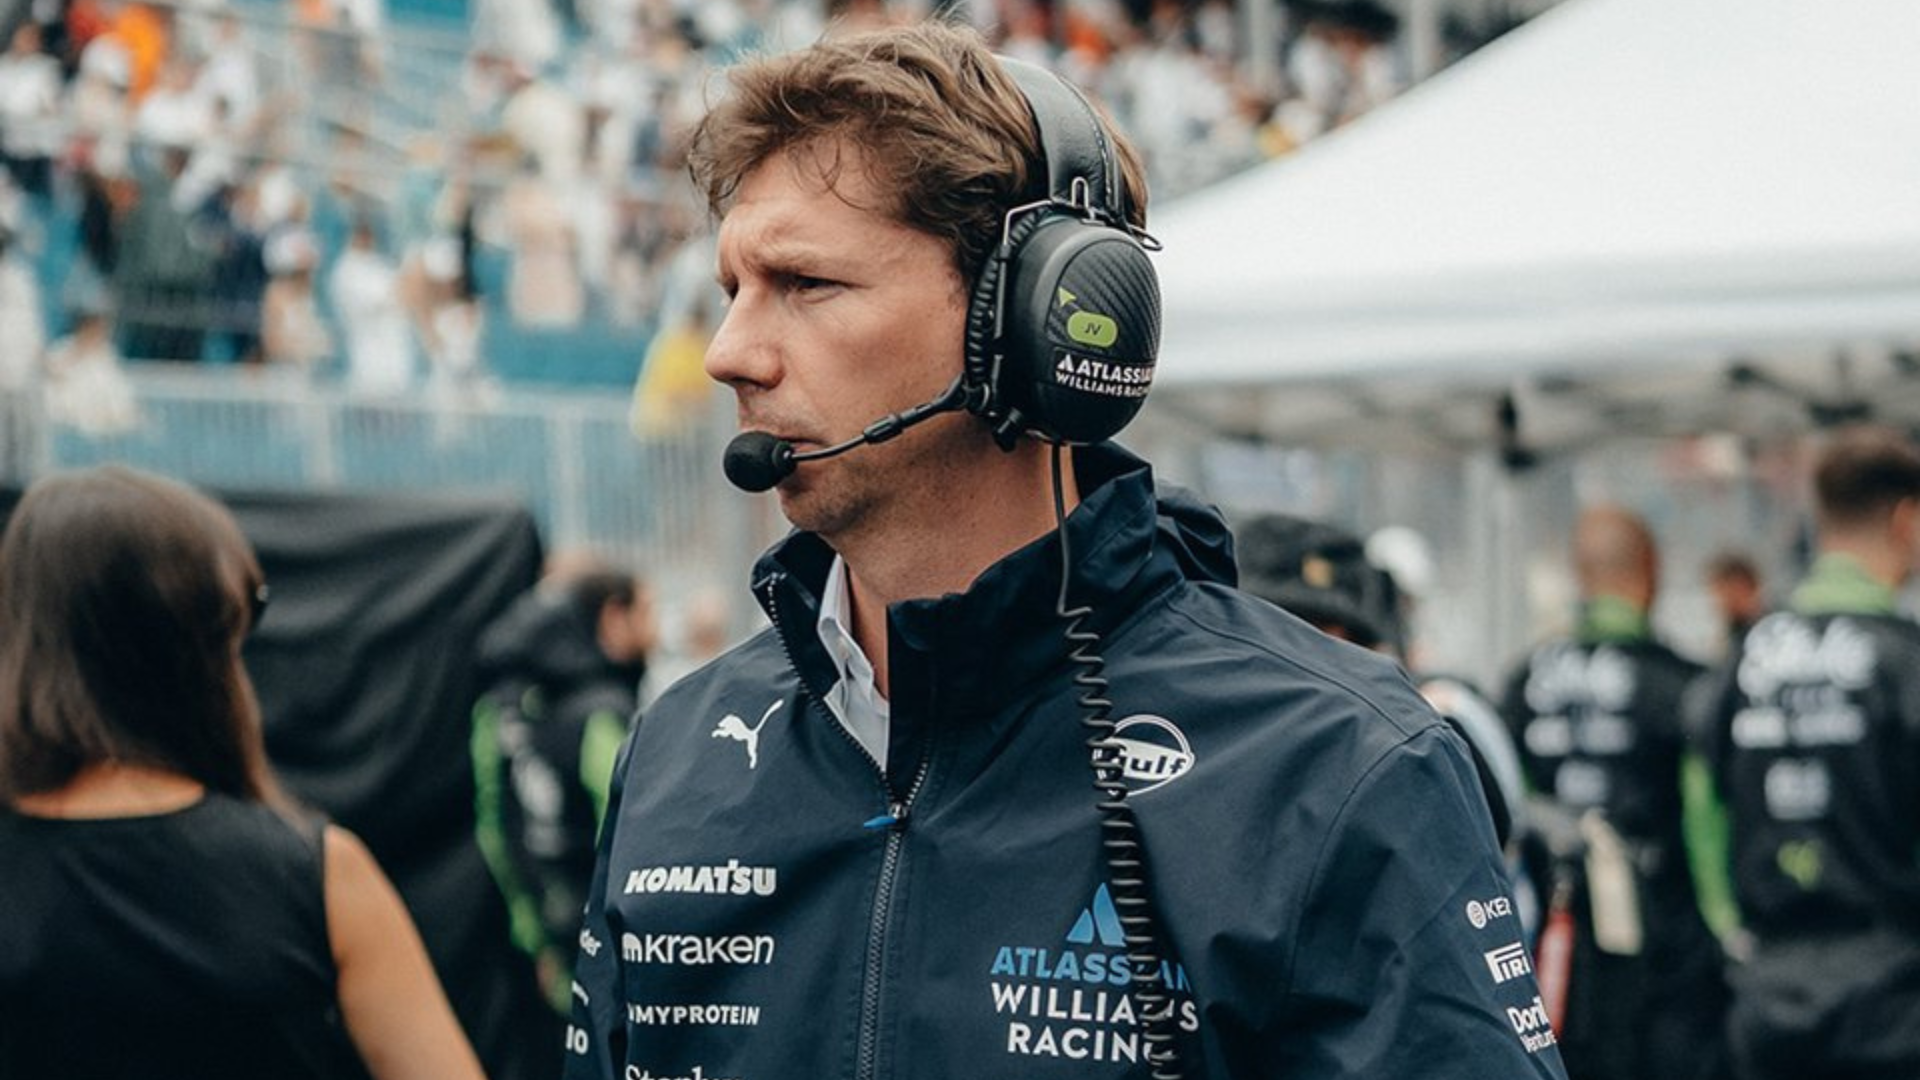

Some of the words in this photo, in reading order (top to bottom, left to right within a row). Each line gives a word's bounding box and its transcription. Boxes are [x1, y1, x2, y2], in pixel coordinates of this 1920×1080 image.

[1085, 323, 1102, 335] JV
[624, 859, 777, 895] KOMATSU
[635, 1005, 760, 1026] MYPROTEIN
[991, 982, 1199, 1031] WILLIAS
